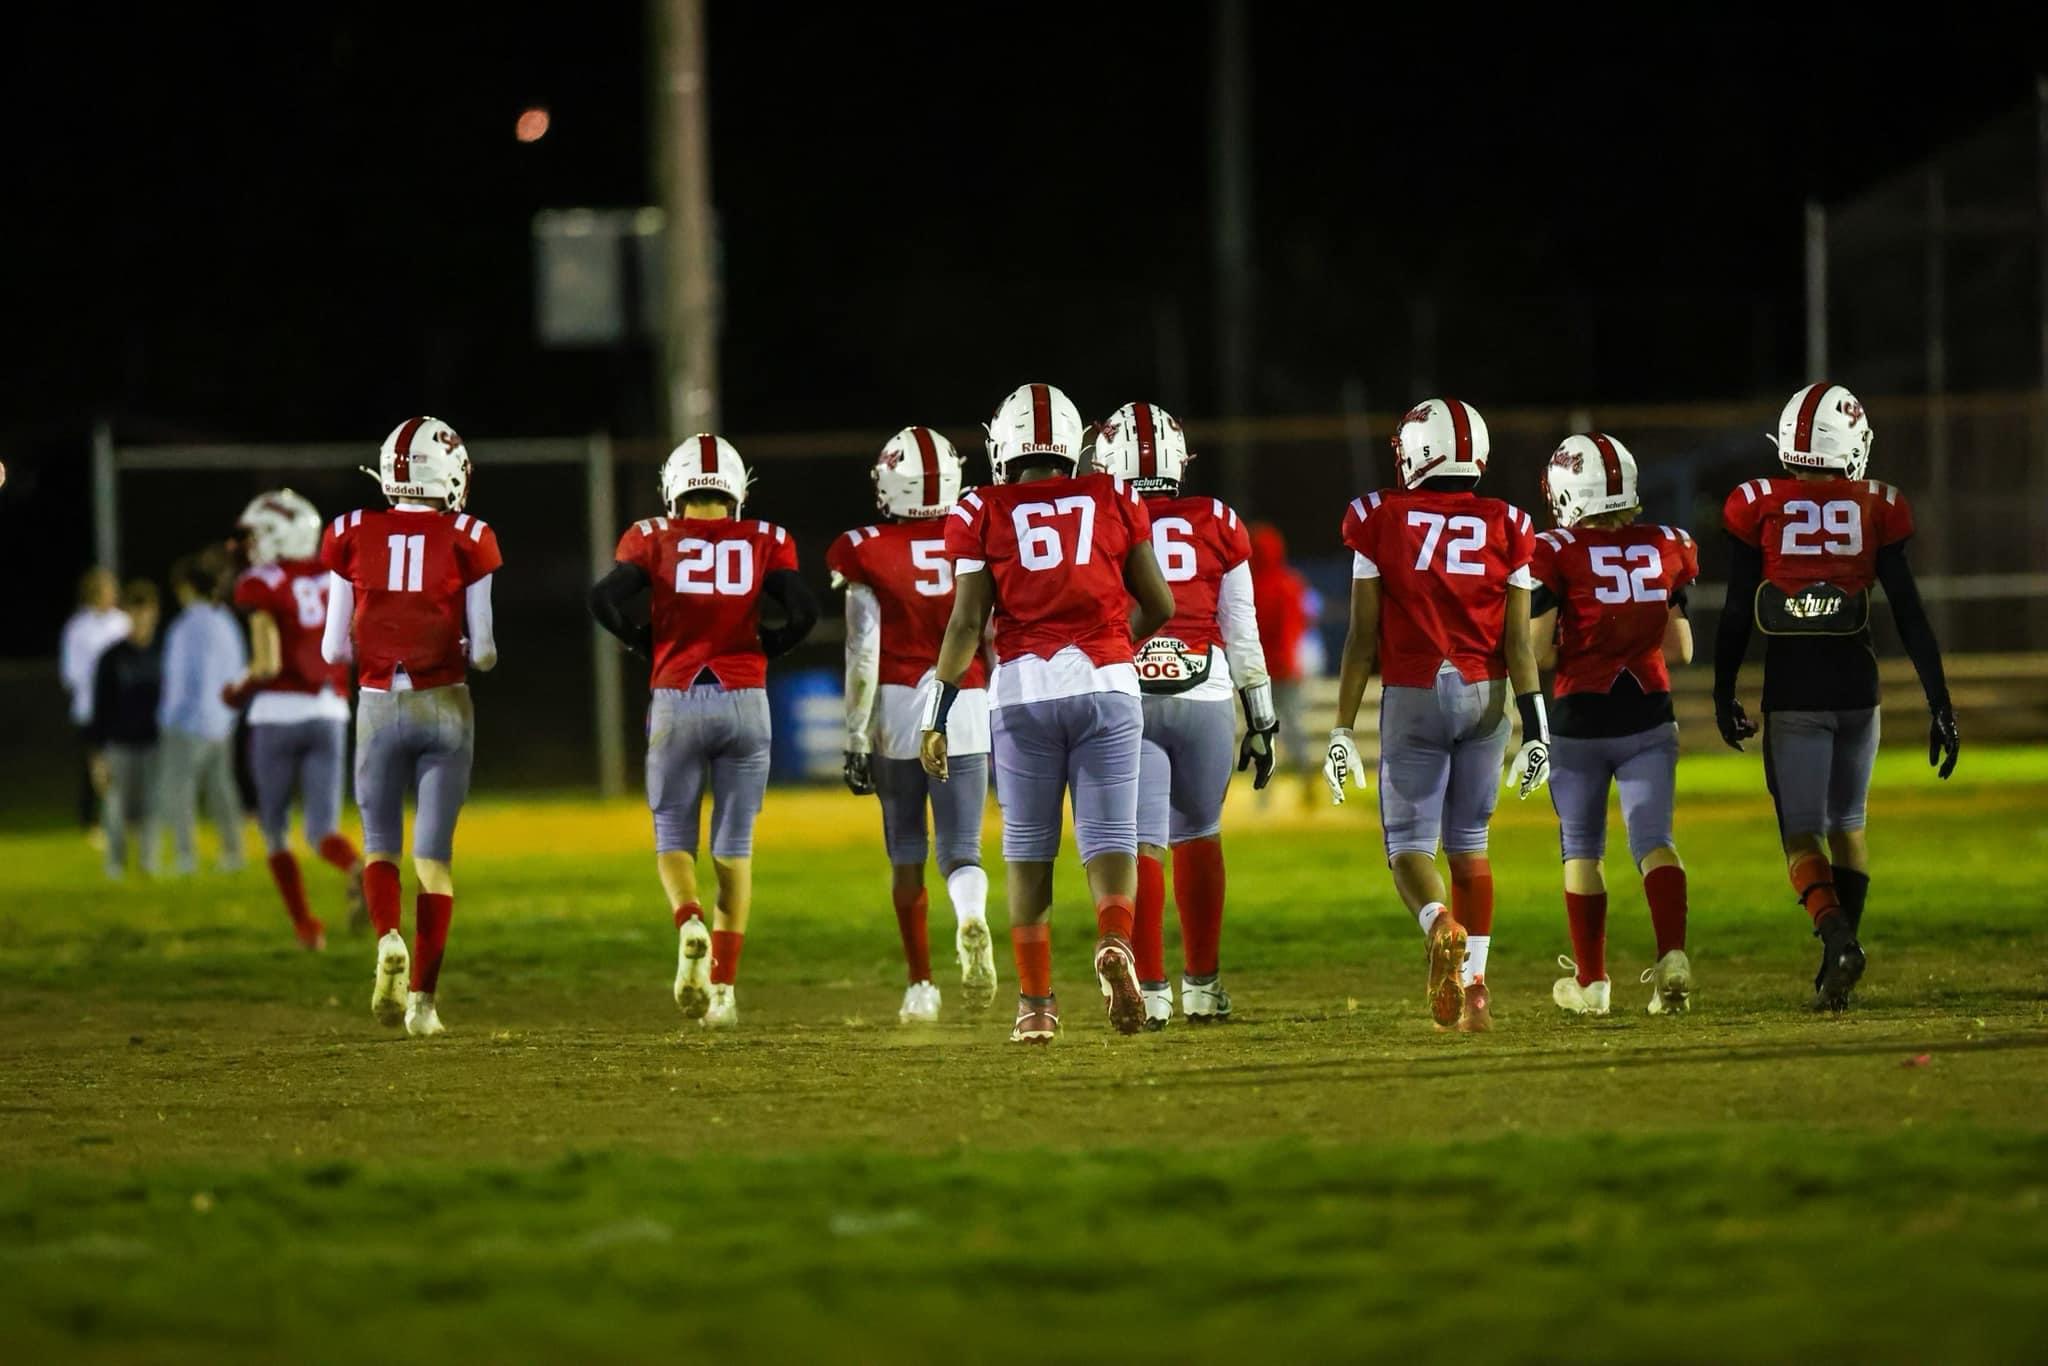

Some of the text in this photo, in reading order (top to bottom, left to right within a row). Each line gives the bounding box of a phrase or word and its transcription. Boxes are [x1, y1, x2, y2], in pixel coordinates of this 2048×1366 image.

[1022, 442, 1067, 454] Riddell
[1783, 451, 1824, 466] Riddell
[384, 484, 424, 496] Riddell
[1012, 495, 1096, 571] 67
[1151, 516, 1198, 582] 6
[1407, 510, 1488, 576] 72
[1780, 499, 1863, 556] 29
[388, 533, 425, 593] 11
[675, 537, 754, 596] 20
[910, 539, 953, 597] 5
[1588, 544, 1668, 604] 52
[1784, 593, 1841, 613] schutt
[1143, 640, 1185, 651] ANGER
